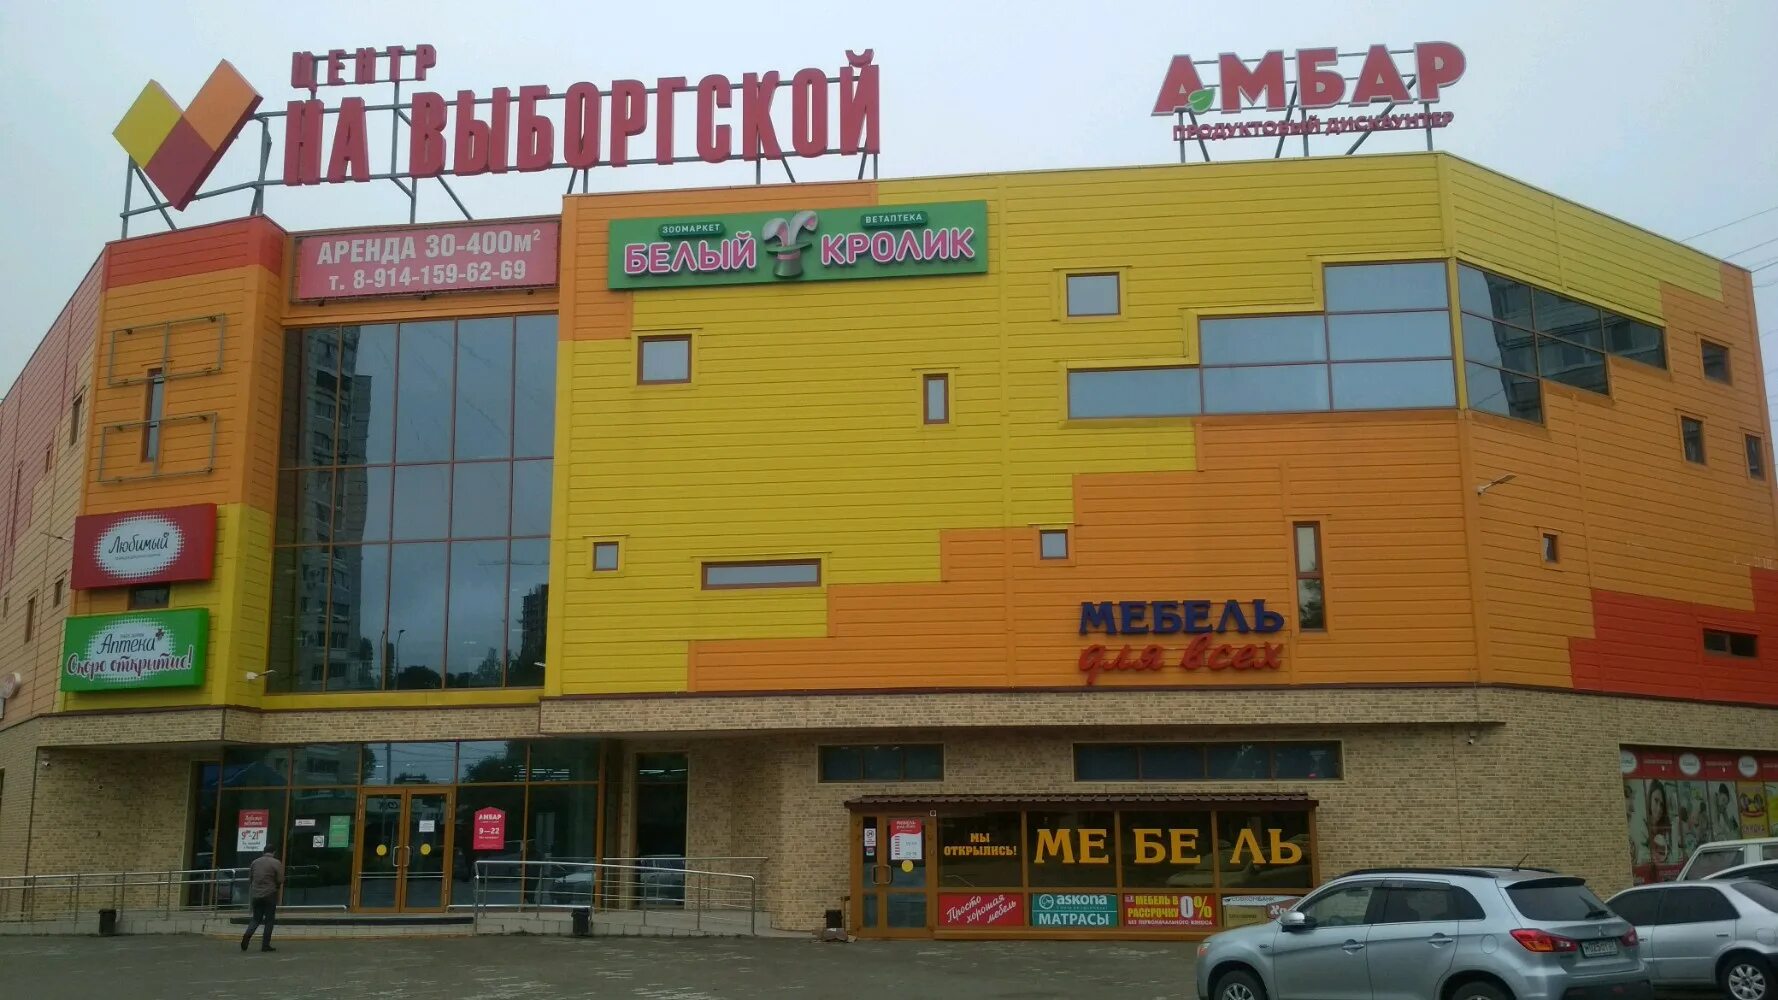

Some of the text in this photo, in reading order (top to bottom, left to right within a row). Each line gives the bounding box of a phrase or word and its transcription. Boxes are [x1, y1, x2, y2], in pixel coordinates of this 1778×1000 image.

[291, 44, 436, 92] ЦЕНТР
[1151, 41, 1466, 116] АМБАР
[283, 48, 879, 186] НА ВЫБОРГСКОЙ
[1173, 111, 1454, 141] ПРОДУКТОВЫЙ ДИСКАУНТЕР
[662, 223, 721, 234] ЗООМАРКЕТ
[865, 213, 922, 224] ВЕТАПТЕКА
[317, 236, 416, 265] АРЕНДА
[624, 227, 975, 275] БЕЛЫЙ КРОЛИК
[354, 260, 526, 290] 8-914-159-62-69
[108, 532, 170, 554] Любимый
[1079, 599, 1285, 636] МЕБЕЛЬ
[97, 634, 155, 654] Аптека
[67, 645, 193, 681] Скоро открытие!
[1078, 632, 1284, 685] для всех
[944, 845, 1017, 856] ОТКРЫЛИСЬ!
[970, 833, 990, 843] МЫ
[946, 895, 982, 923] Просто
[966, 894, 1006, 924] хорошая
[1056, 894, 1107, 905] askona
[1135, 895, 1170, 905] МЕБЕЛЬ
[1172, 896, 1179, 905] В
[1180, 895, 1212, 918] 0%
[986, 901, 1017, 924] мебель
[1039, 913, 1109, 925] МАТРАСЫ
[1128, 908, 1179, 918] РАССРОЧКУ
